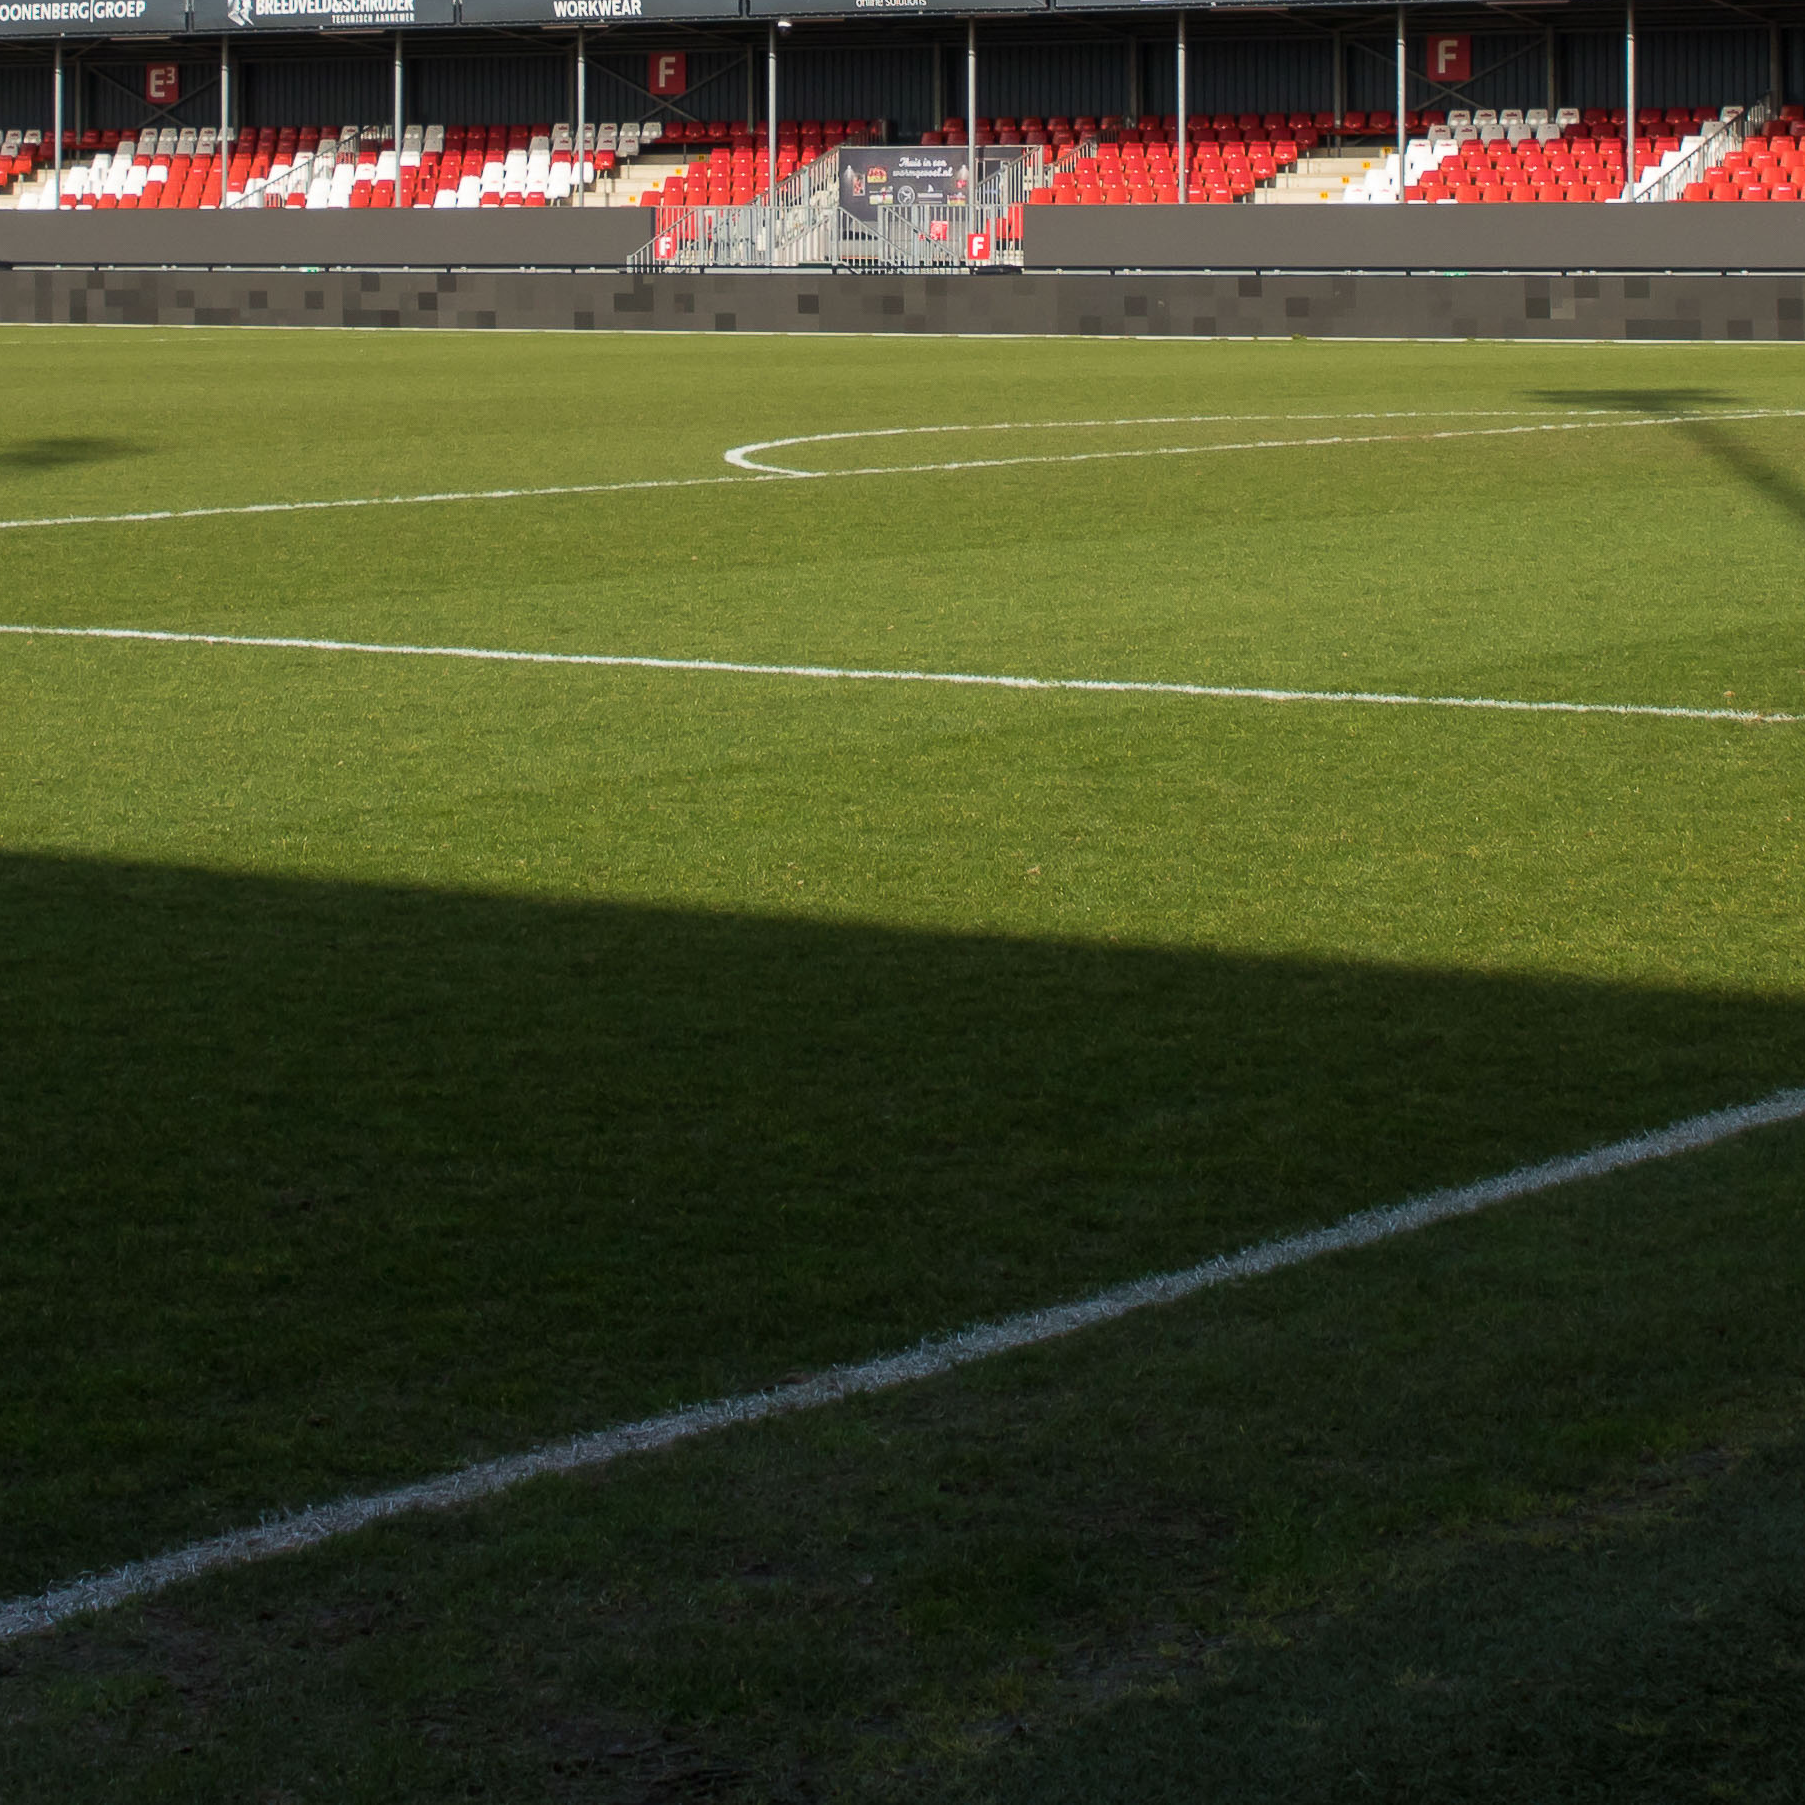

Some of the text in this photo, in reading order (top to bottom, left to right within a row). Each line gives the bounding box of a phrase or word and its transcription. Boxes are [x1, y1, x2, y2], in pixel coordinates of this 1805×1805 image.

[553, 0, 642, 18] WORKWEAR
[1438, 40, 1458, 74] F
[658, 56, 676, 88] F
[659, 236, 671, 256] F
[972, 236, 985, 257] F
